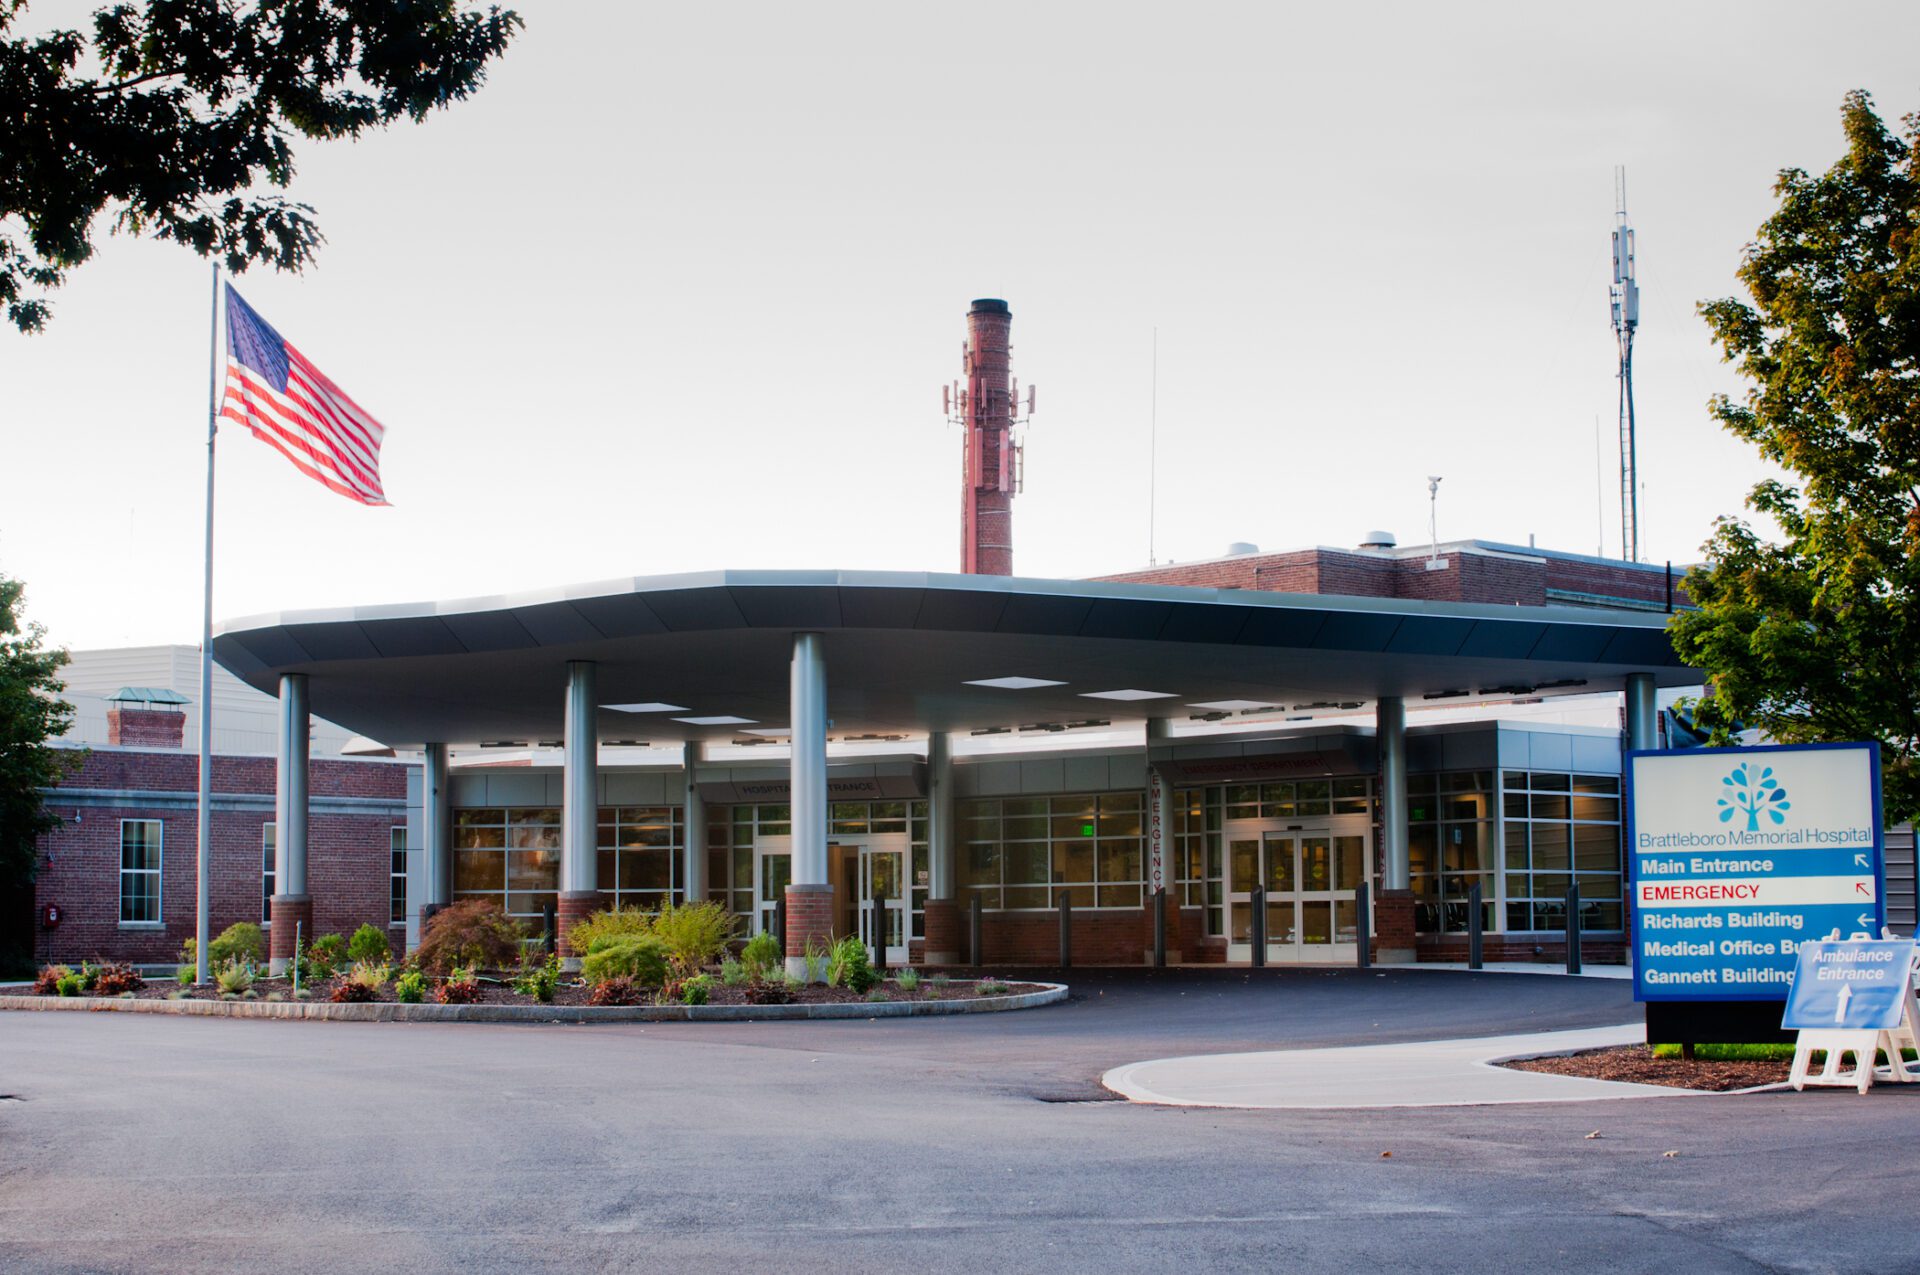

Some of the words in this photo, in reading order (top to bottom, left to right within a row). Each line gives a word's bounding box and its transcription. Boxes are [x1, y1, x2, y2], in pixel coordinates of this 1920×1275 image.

[742, 784, 791, 795] HOSPITA
[827, 782, 875, 792] TRANCE
[1151, 775, 1162, 892] EMERGENCY
[1639, 832, 1727, 848] Brattleboro
[1729, 829, 1803, 845] Memorial
[1806, 827, 1871, 844] Hospital
[1641, 859, 1685, 874] Main
[1690, 858, 1774, 873] Entrance
[1643, 885, 1760, 900] EMERGENCY
[1643, 913, 1723, 929] Richards
[1727, 912, 1804, 930] Building
[1644, 940, 1715, 956] Medical
[1720, 940, 1775, 955] Office
[1812, 949, 1893, 962] Ambulance
[1645, 968, 1717, 984] Gannett
[1722, 968, 1794, 985] Building
[1817, 967, 1884, 980] Entrance
